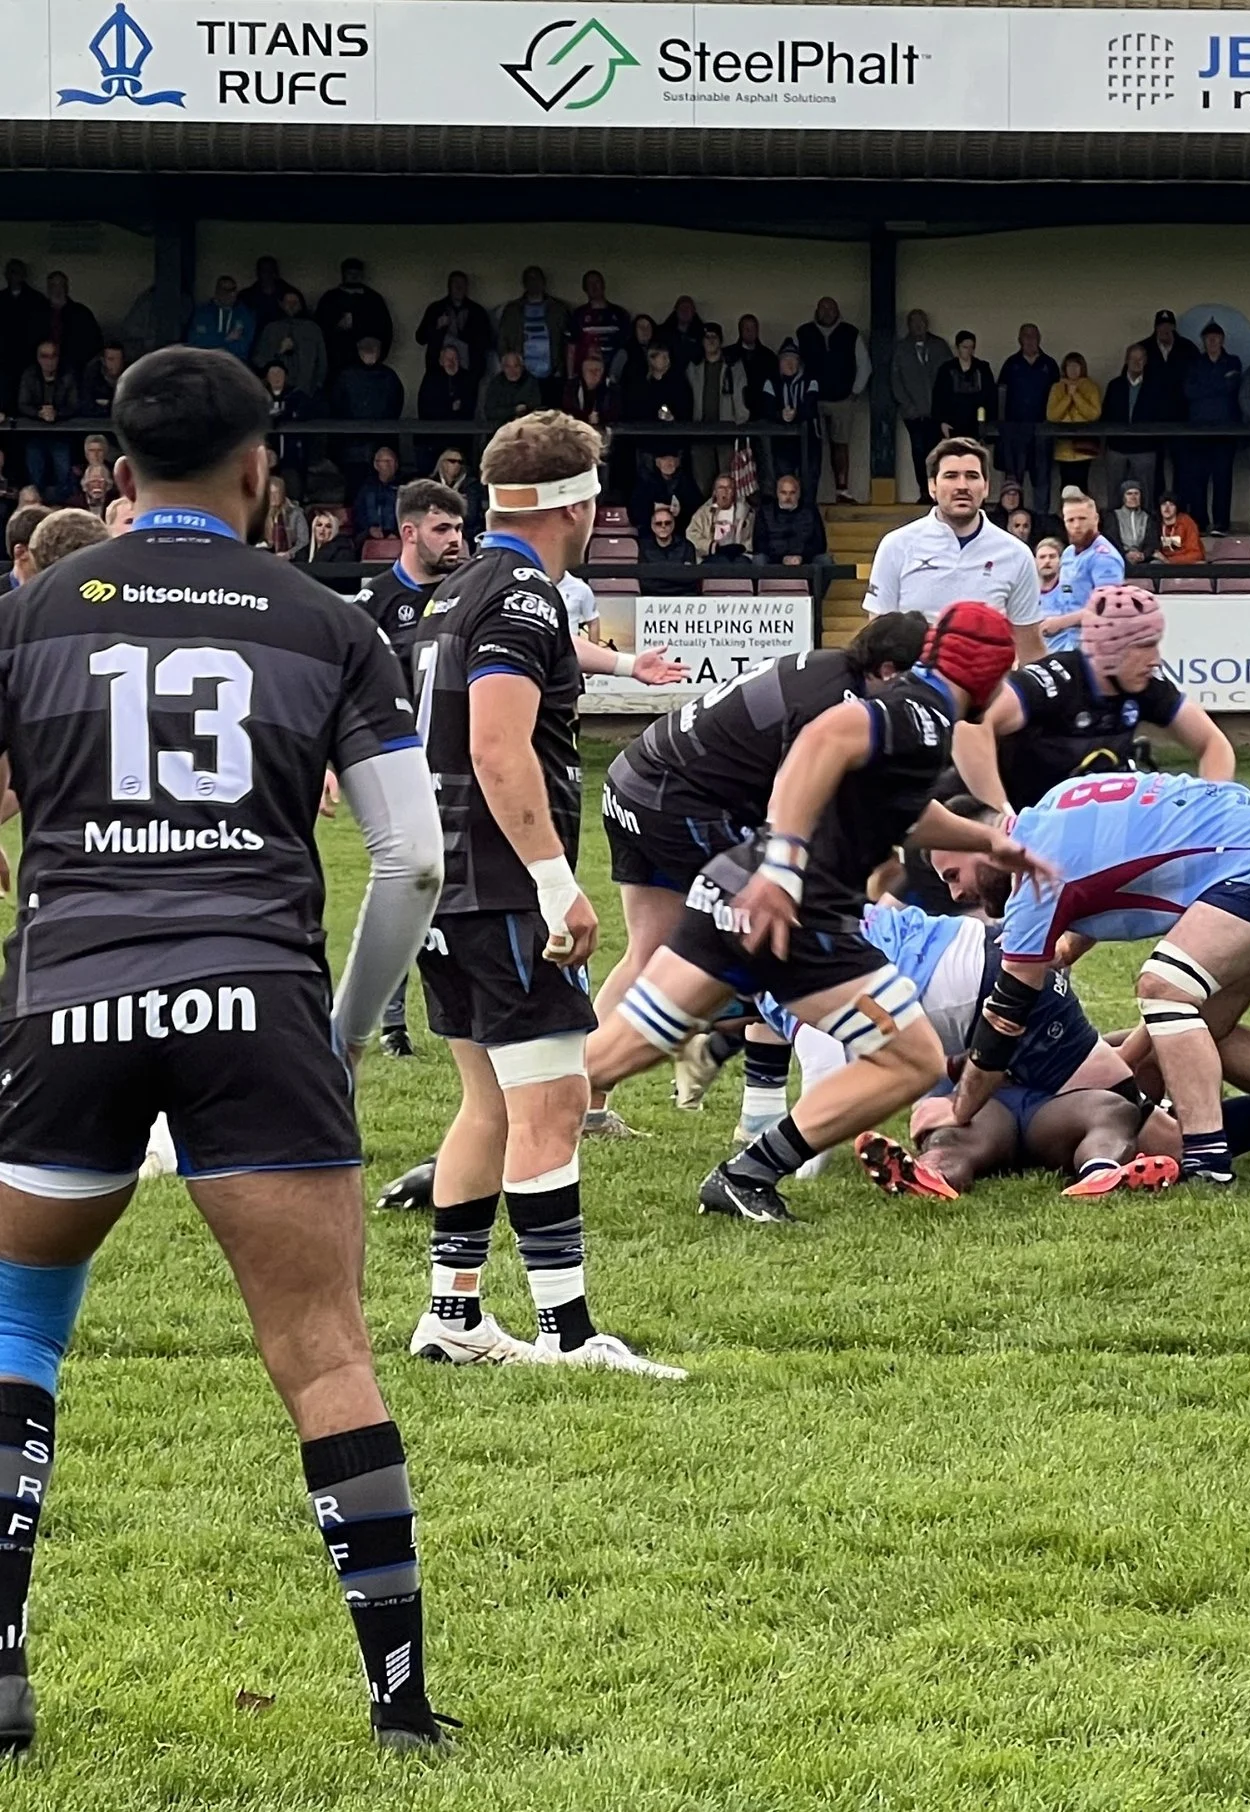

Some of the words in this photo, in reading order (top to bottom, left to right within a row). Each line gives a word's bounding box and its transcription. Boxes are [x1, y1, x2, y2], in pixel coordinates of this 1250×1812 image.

[196, 20, 369, 57] TITANS
[219, 70, 347, 106] RUFC
[663, 91, 731, 102] Sustainable
[735, 92, 779, 104] Asphalt
[783, 92, 837, 104] Solutions
[153, 514, 173, 525] Est
[122, 583, 269, 611] bitsolutions
[645, 603, 707, 615] AWARD
[716, 603, 794, 615] WINNING
[643, 619, 679, 634] MEN
[685, 619, 753, 634] HELPING
[759, 619, 794, 634] MEN
[643, 638, 665, 647] Men
[667, 637, 707, 649] Actually
[709, 637, 746, 649] Talking
[748, 637, 792, 649] Together
[89, 642, 254, 804] 13
[1056, 776, 1138, 810] 8
[84, 819, 265, 854] Mullucks
